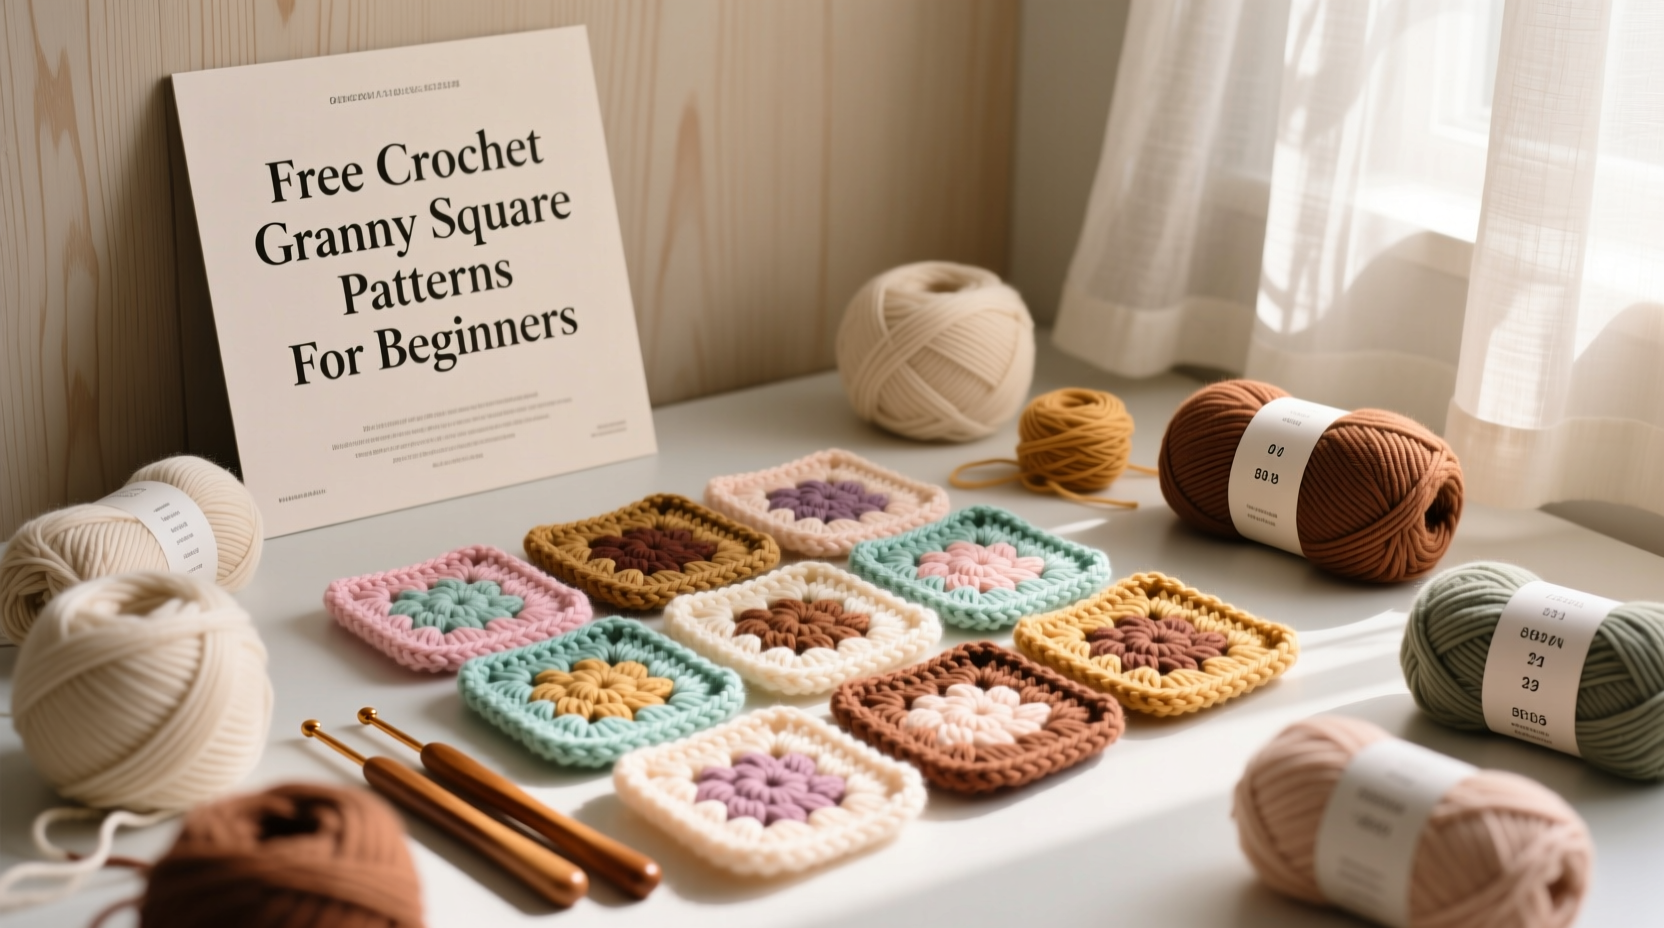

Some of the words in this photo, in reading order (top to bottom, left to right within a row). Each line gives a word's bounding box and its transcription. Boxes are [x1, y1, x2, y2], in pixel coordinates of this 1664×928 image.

[265, 159, 365, 204] Free
[376, 129, 544, 186] Crochet
[254, 214, 418, 266] Granny
[429, 189, 572, 247] Square
[338, 257, 514, 316] Patterns
[288, 342, 364, 387] For
[373, 305, 579, 373] Beginners
